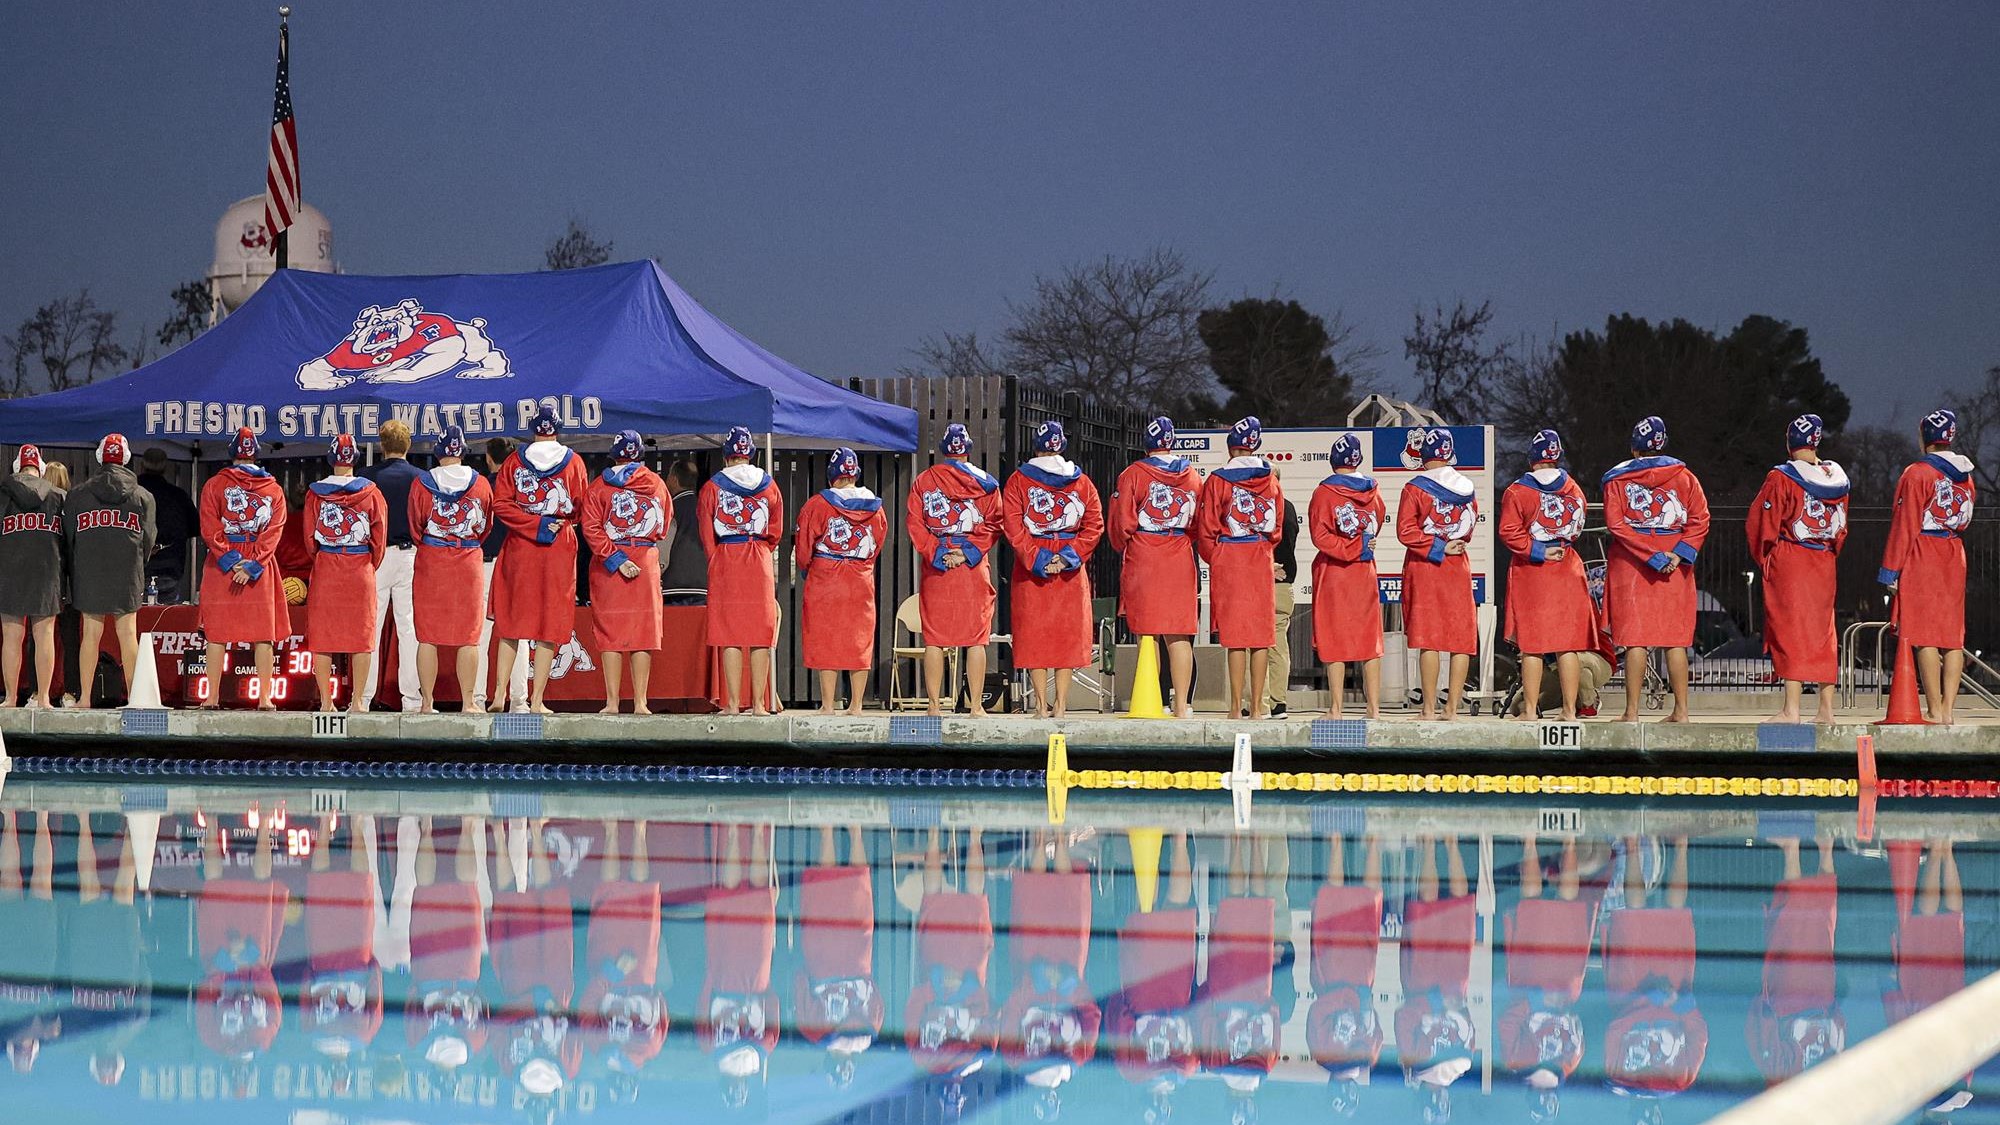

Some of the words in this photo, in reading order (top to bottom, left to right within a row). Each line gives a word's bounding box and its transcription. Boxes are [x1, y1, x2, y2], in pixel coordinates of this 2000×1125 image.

[145, 400, 267, 435] FRESNO
[278, 403, 380, 437] STATE
[391, 402, 505, 436] WATER
[517, 394, 603, 430] PLO
[1794, 415, 1813, 433] 20
[1927, 410, 1948, 428] 23
[1037, 423, 1049, 437] 9
[1148, 420, 1162, 437] 10
[1184, 439, 1205, 449] CAPS
[2, 512, 62, 536] BIOLA
[76, 508, 141, 533] BIOLA
[288, 651, 312, 674] 30
[315, 716, 346, 734] 11FT
[1541, 725, 1580, 746] 16FT
